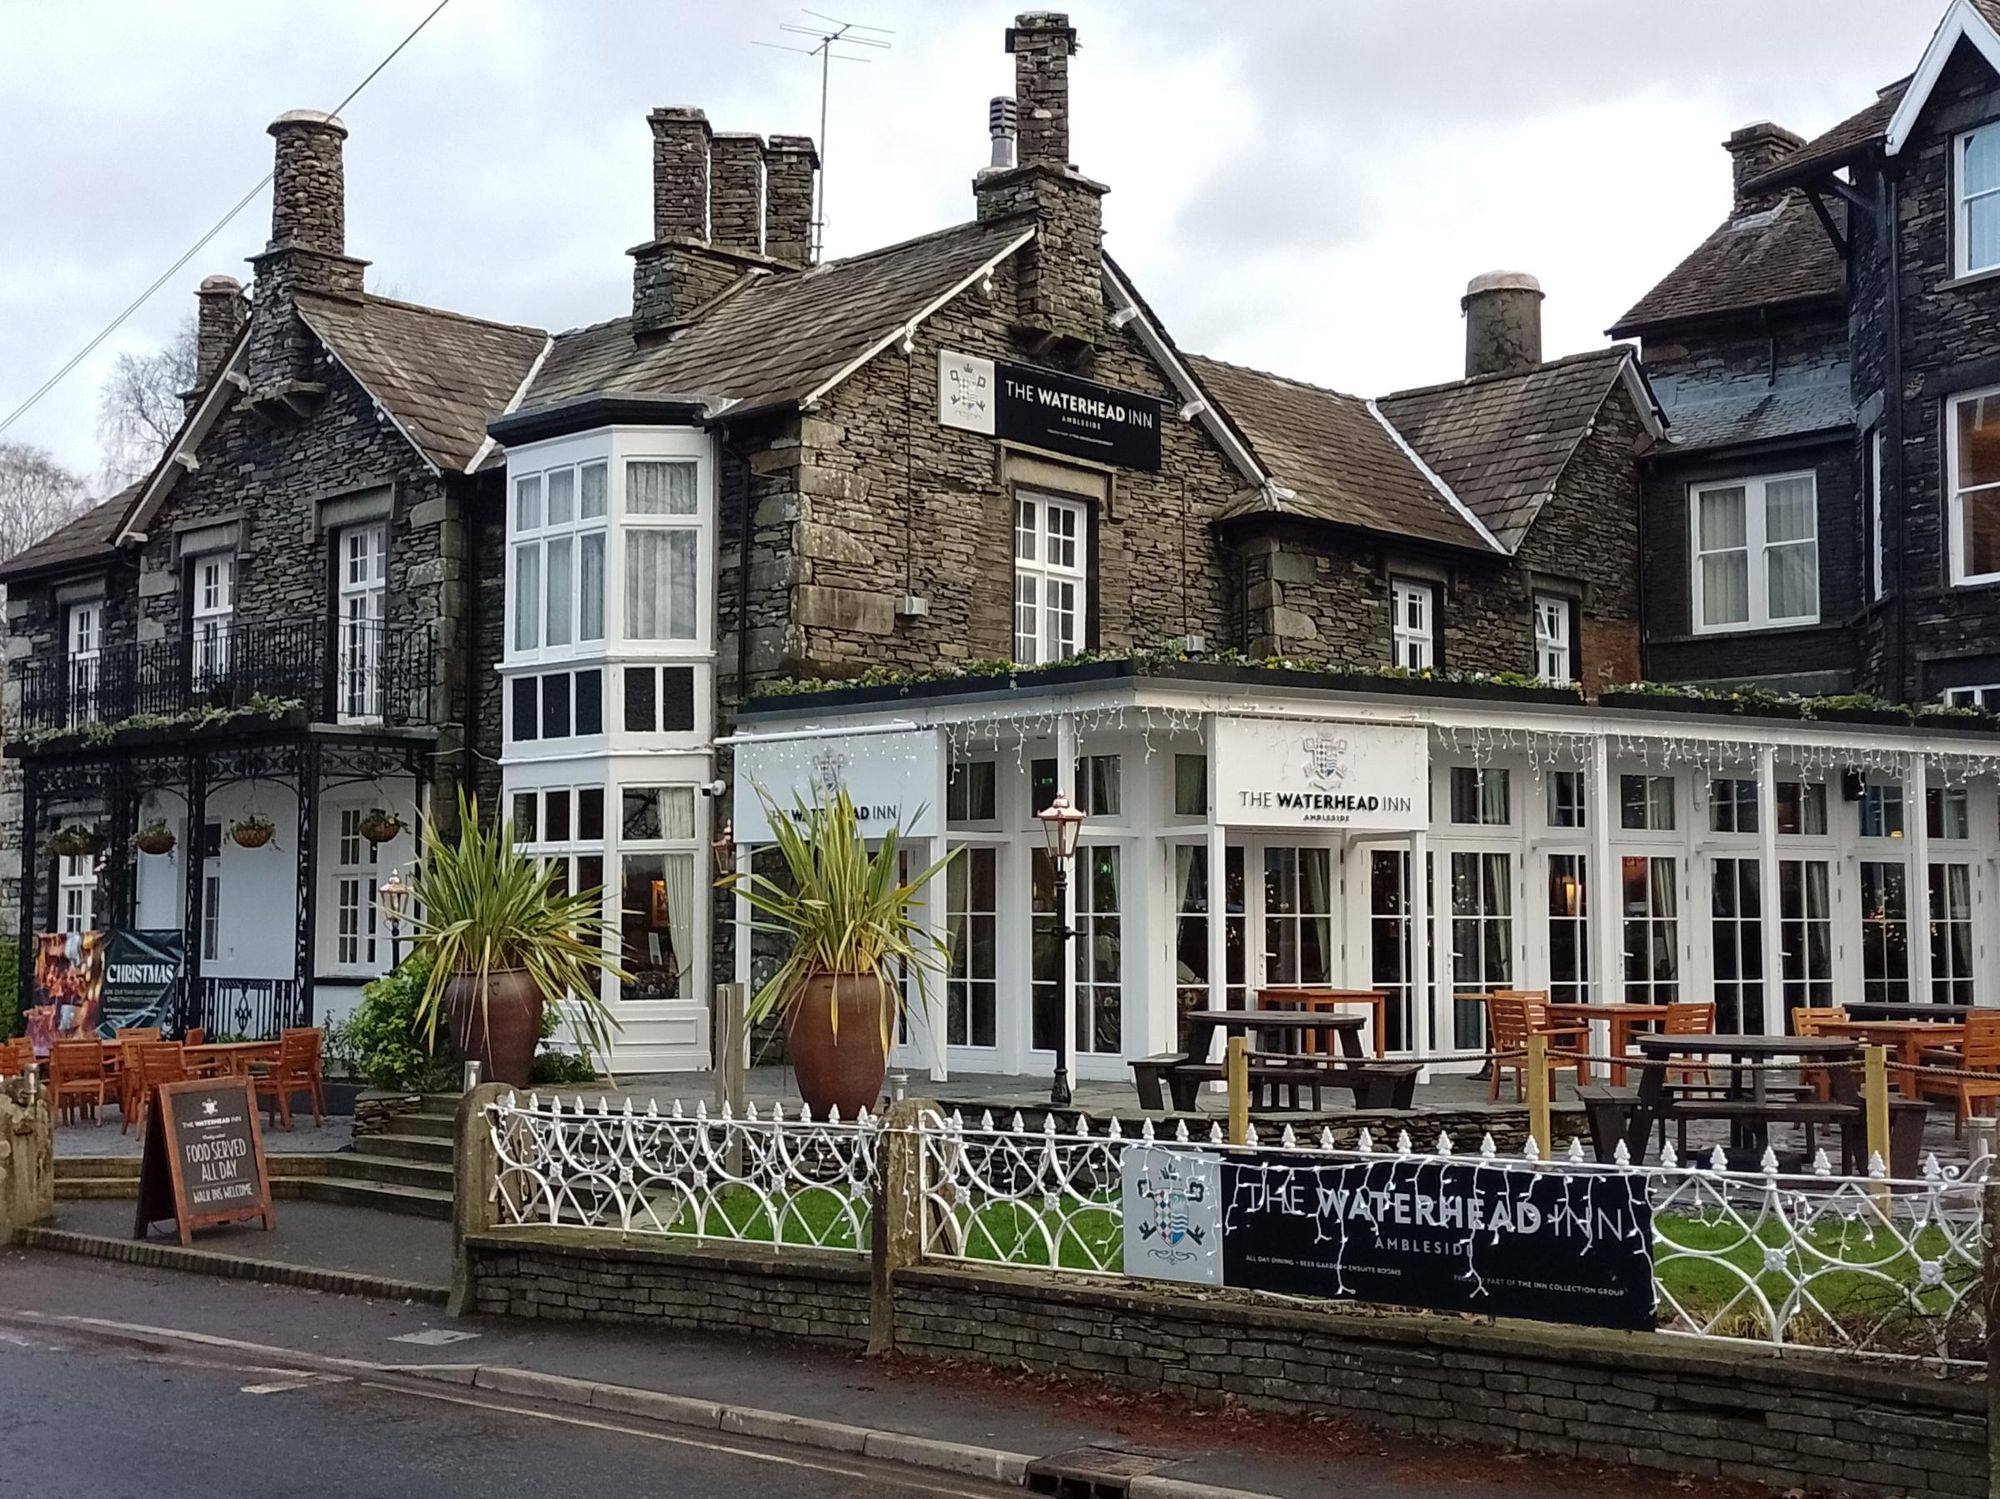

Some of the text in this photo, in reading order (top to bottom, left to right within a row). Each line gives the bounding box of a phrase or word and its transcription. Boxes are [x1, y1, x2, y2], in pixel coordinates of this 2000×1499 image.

[1005, 379, 1153, 430] THE WATERHEAD INN
[1061, 415, 1101, 430] AMBLESIDE
[1239, 790, 1411, 812] THE WATERHEAD INN
[872, 804, 897, 820] INN
[1303, 814, 1350, 822] AMBLESIDE
[106, 964, 174, 983] CHRISTMAS
[182, 1121, 194, 1129] THE
[194, 1117, 230, 1127] WATERHEAD
[185, 1138, 246, 1163] FOOD SERVED
[202, 1160, 237, 1182] ALL DAY
[193, 1189, 211, 1204] WALK
[223, 1183, 253, 1198] WELCOME
[1243, 1183, 1623, 1241] THE WATERHEAD INN
[1271, 1257, 1294, 1265] DINING
[1348, 1264, 1376, 1273] ENSUITE
[1487, 1277, 1504, 1285] PART
[1507, 1278, 1516, 1286] OF
[1518, 1280, 1532, 1288] THE
[1534, 1281, 1548, 1289] INN
[1549, 1282, 1596, 1294] COLLECTION
[1597, 1287, 1625, 1297] GROUP
